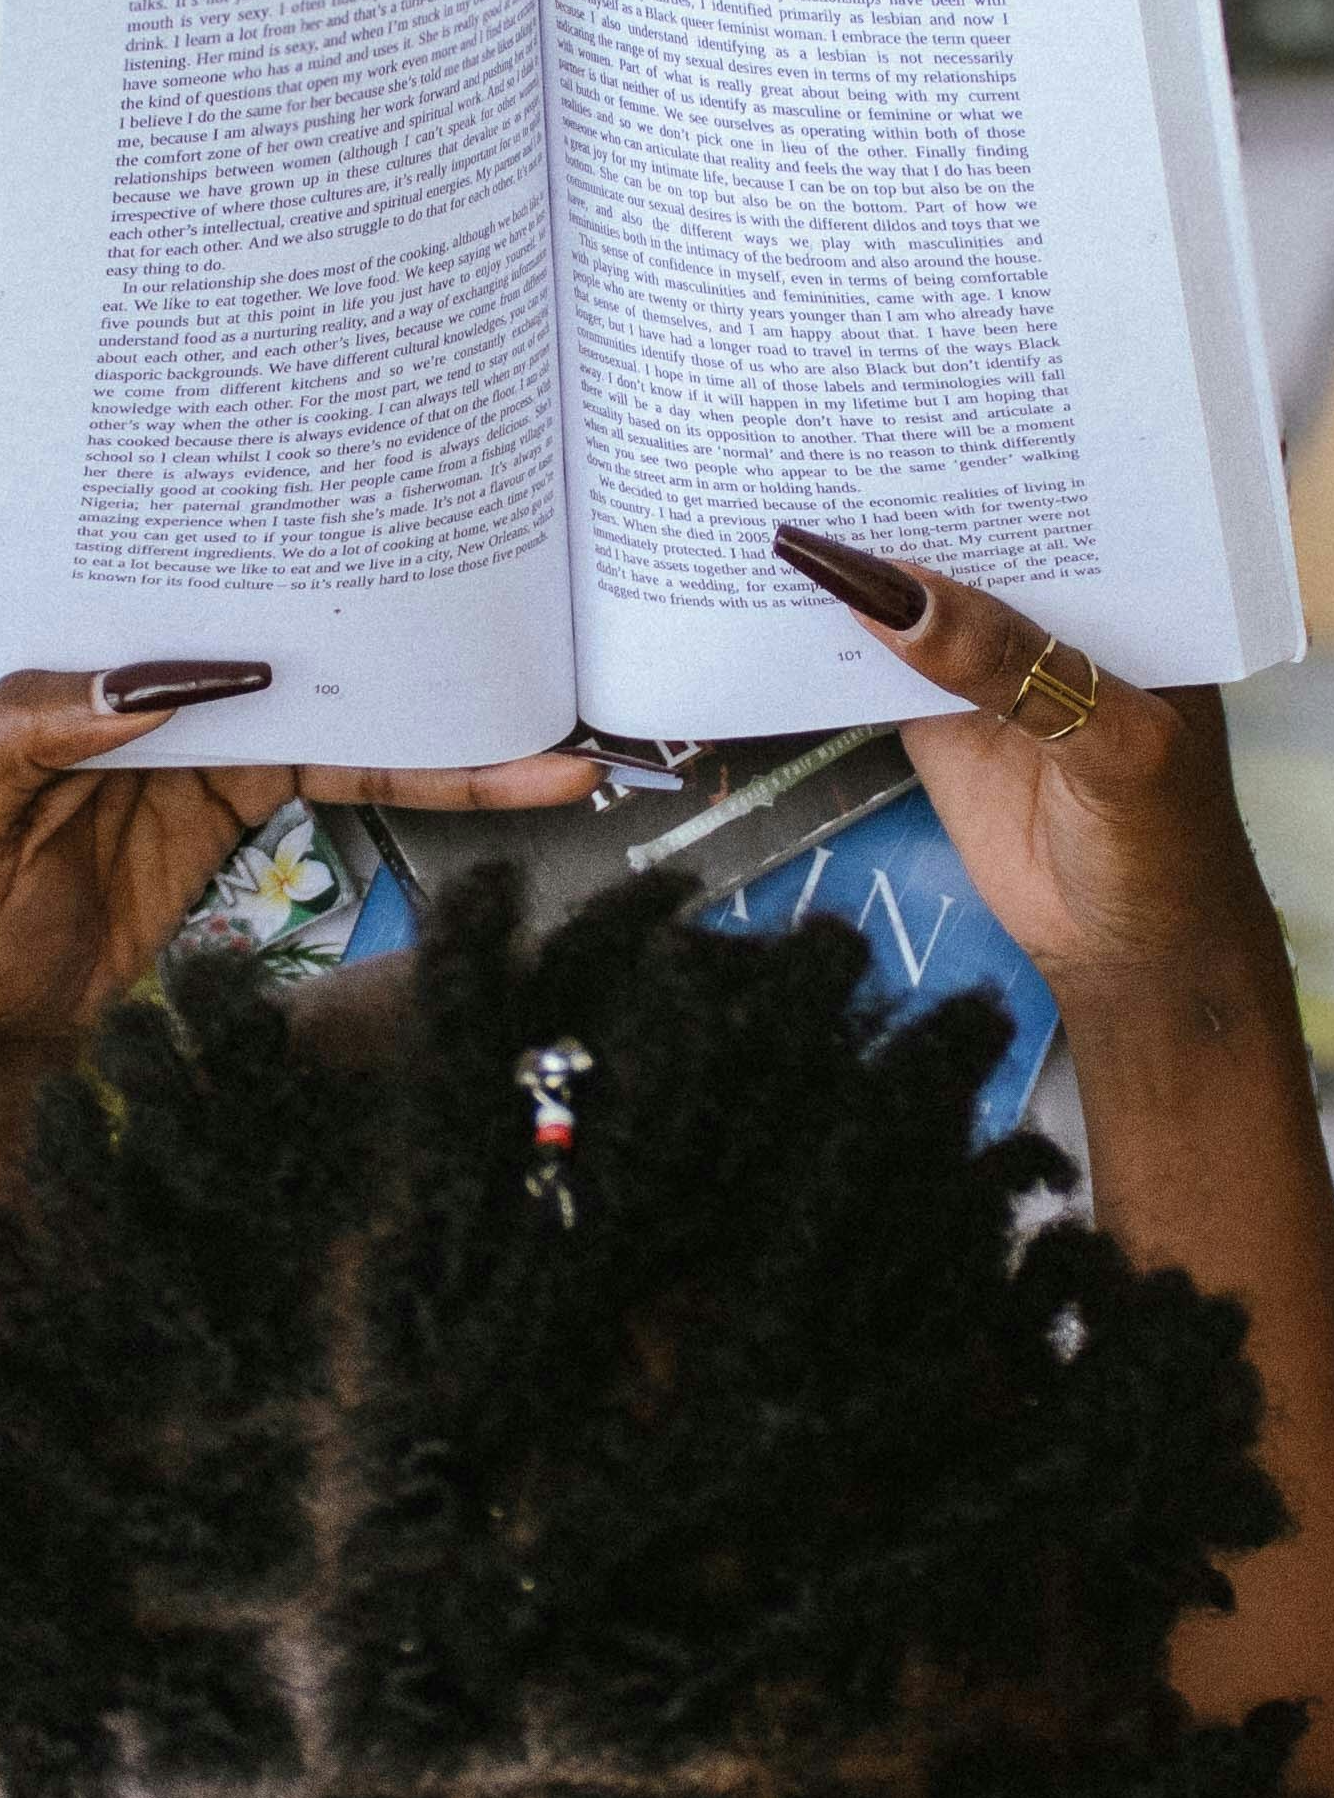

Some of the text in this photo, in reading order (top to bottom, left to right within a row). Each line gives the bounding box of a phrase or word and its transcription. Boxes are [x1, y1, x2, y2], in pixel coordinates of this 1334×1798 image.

[777, 8, 842, 26] primarily
[848, 12, 865, 24] as
[870, 10, 922, 26] lesbian
[928, 11, 956, 26] and
[962, 14, 995, 26] now
[1001, 11, 1008, 26] I
[116, 78, 461, 150] me, because I am always pushing her work forward
[595, 110, 1030, 161] and so we don't pick one in lieu of the other. Finally finding
[107, 226, 143, 241] each
[146, 223, 199, 239] other's
[201, 214, 286, 235] intellectual,
[288, 208, 344, 226] creative
[345, 199, 371, 218] and
[372, 187, 424, 214] spiritual
[424, 176, 474, 199] energies.
[104, 257, 225, 279] easy thing to do.
[122, 277, 138, 294] In
[140, 282, 166, 294] our
[170, 274, 257, 292] relationship
[259, 271, 285, 286] she
[286, 267, 320, 282] does
[322, 261, 356, 277] most
[358, 255, 373, 272] of
[375, 253, 397, 268] the
[398, 241, 450, 263] cooking,
[610, 422, 1076, 461] all sexualities are 'normal' and there is no reason to think differently
[587, 487, 607, 505] this
[608, 497, 654, 519] country.
[657, 505, 665, 519] I
[667, 504, 692, 522] had
[695, 512, 705, 523] a
[707, 514, 767, 533] previous
[824, 514, 856, 526] who
[860, 512, 868, 525] I
[871, 510, 900, 524] had
[902, 509, 939, 521] been
[942, 503, 976, 517] with
[980, 500, 1001, 514] for
[1006, 489, 1089, 510] twenty-two
[70, 530, 548, 591] is known for its food culture so it's really hard to lose those five pounds.
[596, 577, 641, 600] dragged
[641, 590, 667, 604] two
[668, 592, 715, 608] friends
[717, 591, 749, 609] with
[750, 598, 769, 609] us
[770, 598, 787, 608] as
[968, 576, 981, 588] of
[985, 573, 1025, 588] paper
[1029, 567, 1056, 581] and
[1058, 567, 1070, 578] it
[1072, 565, 1102, 576] was
[837, 650, 861, 661] 101
[315, 684, 340, 695] 100
